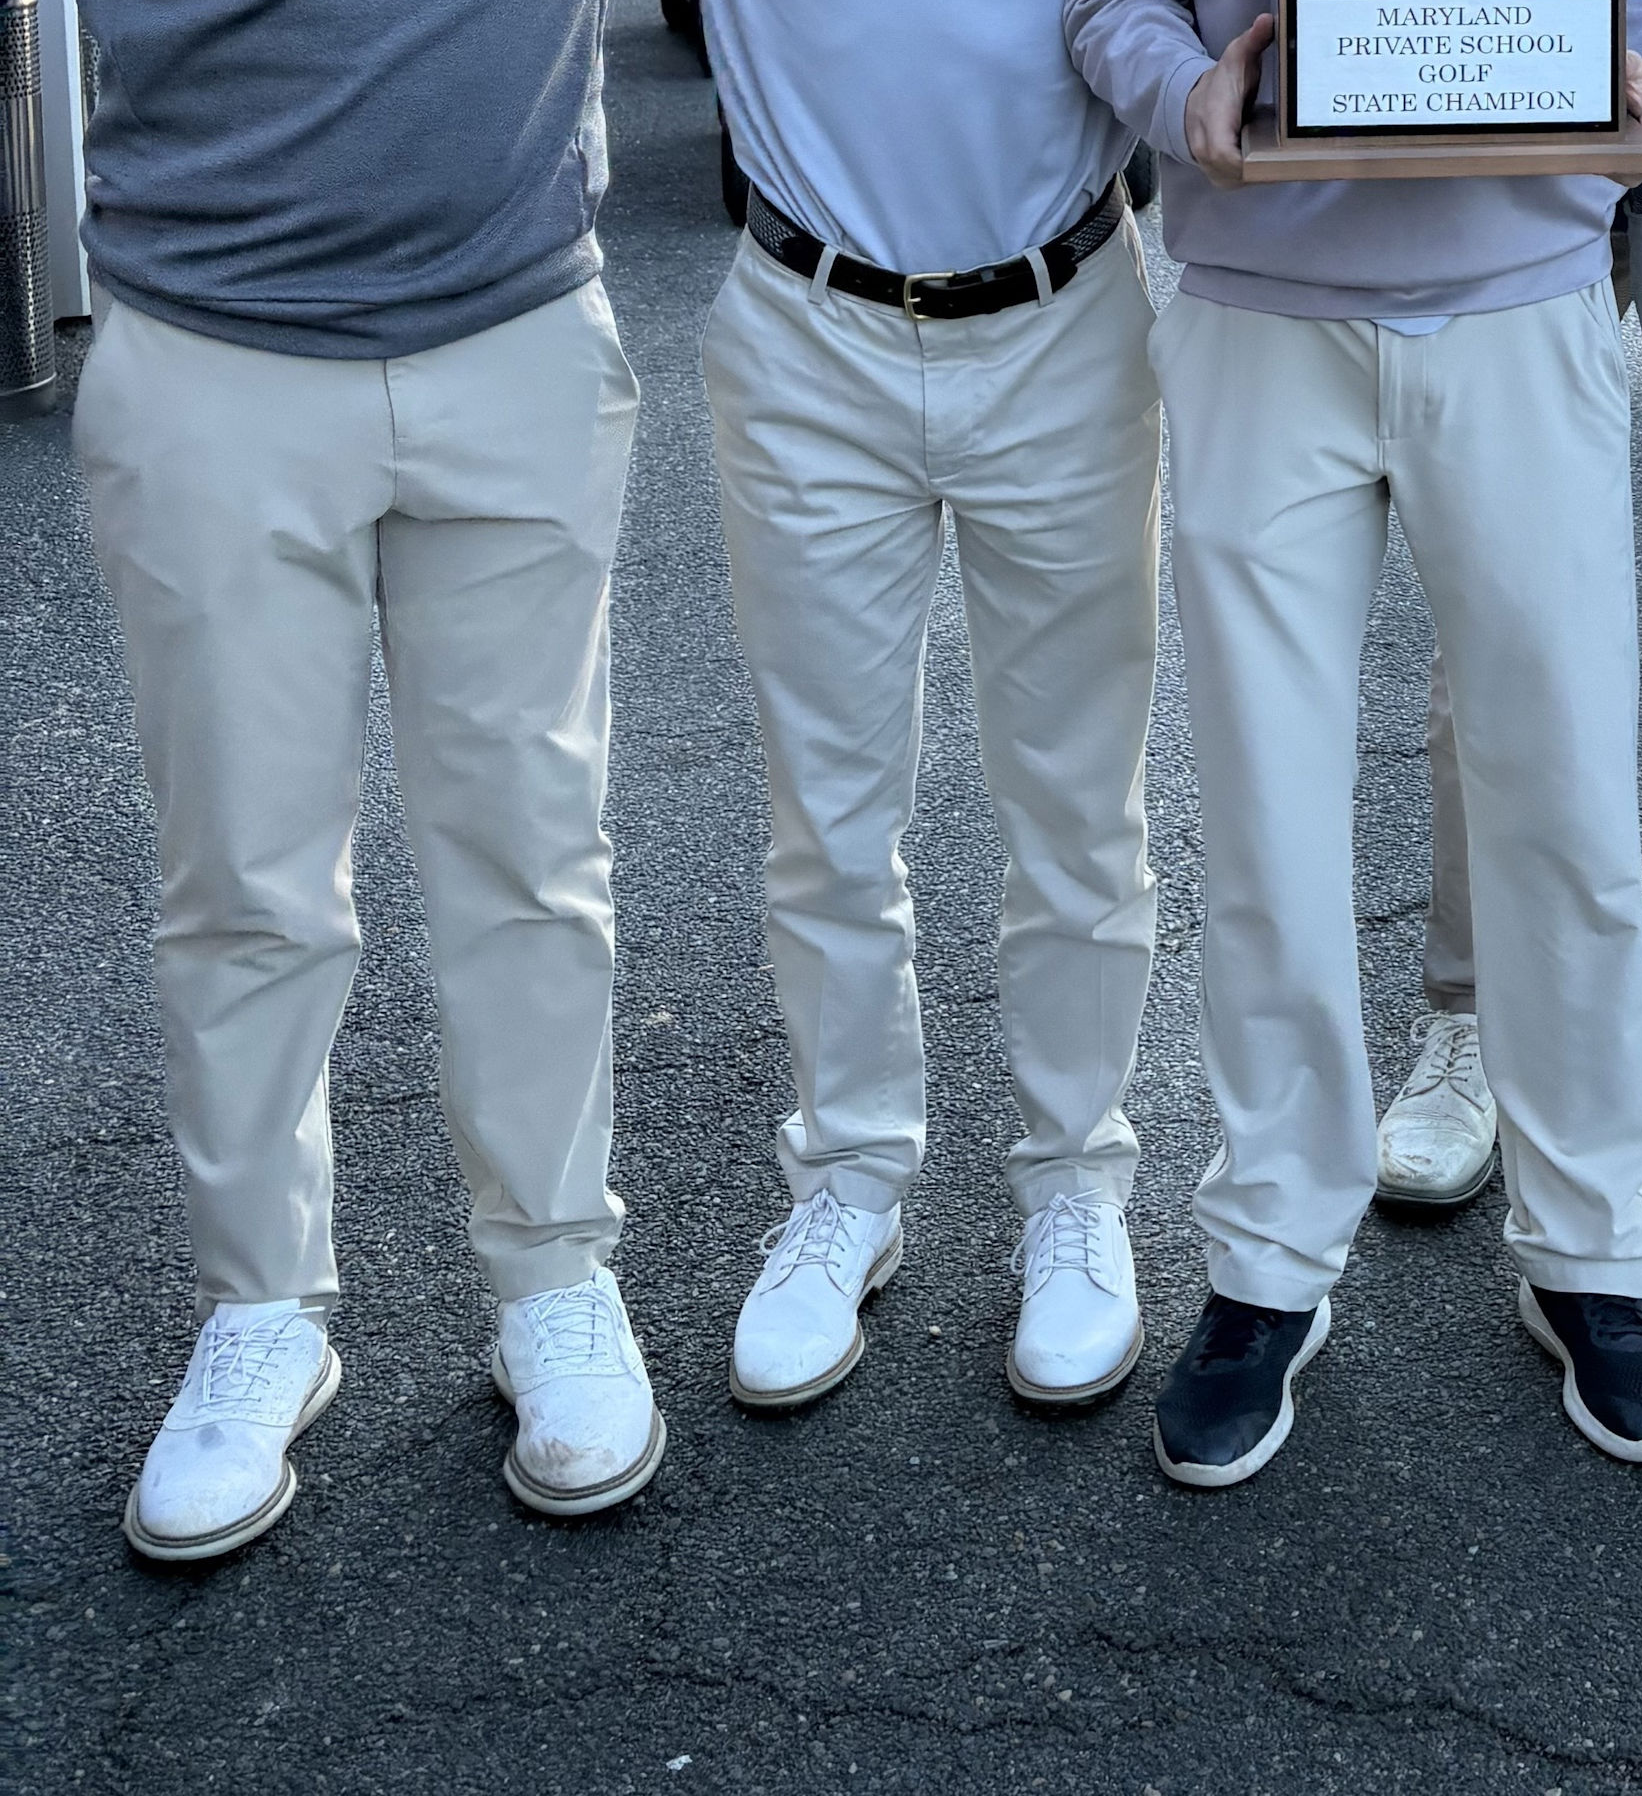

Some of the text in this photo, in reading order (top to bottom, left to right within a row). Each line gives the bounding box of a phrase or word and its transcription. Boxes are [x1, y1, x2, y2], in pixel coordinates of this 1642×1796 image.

[1376, 5, 1533, 27] MARYLAND
[1336, 33, 1574, 56] PRIVATE SCHOOL
[1417, 63, 1494, 84] GOLF
[1331, 90, 1577, 114] STATE CHAMPION
